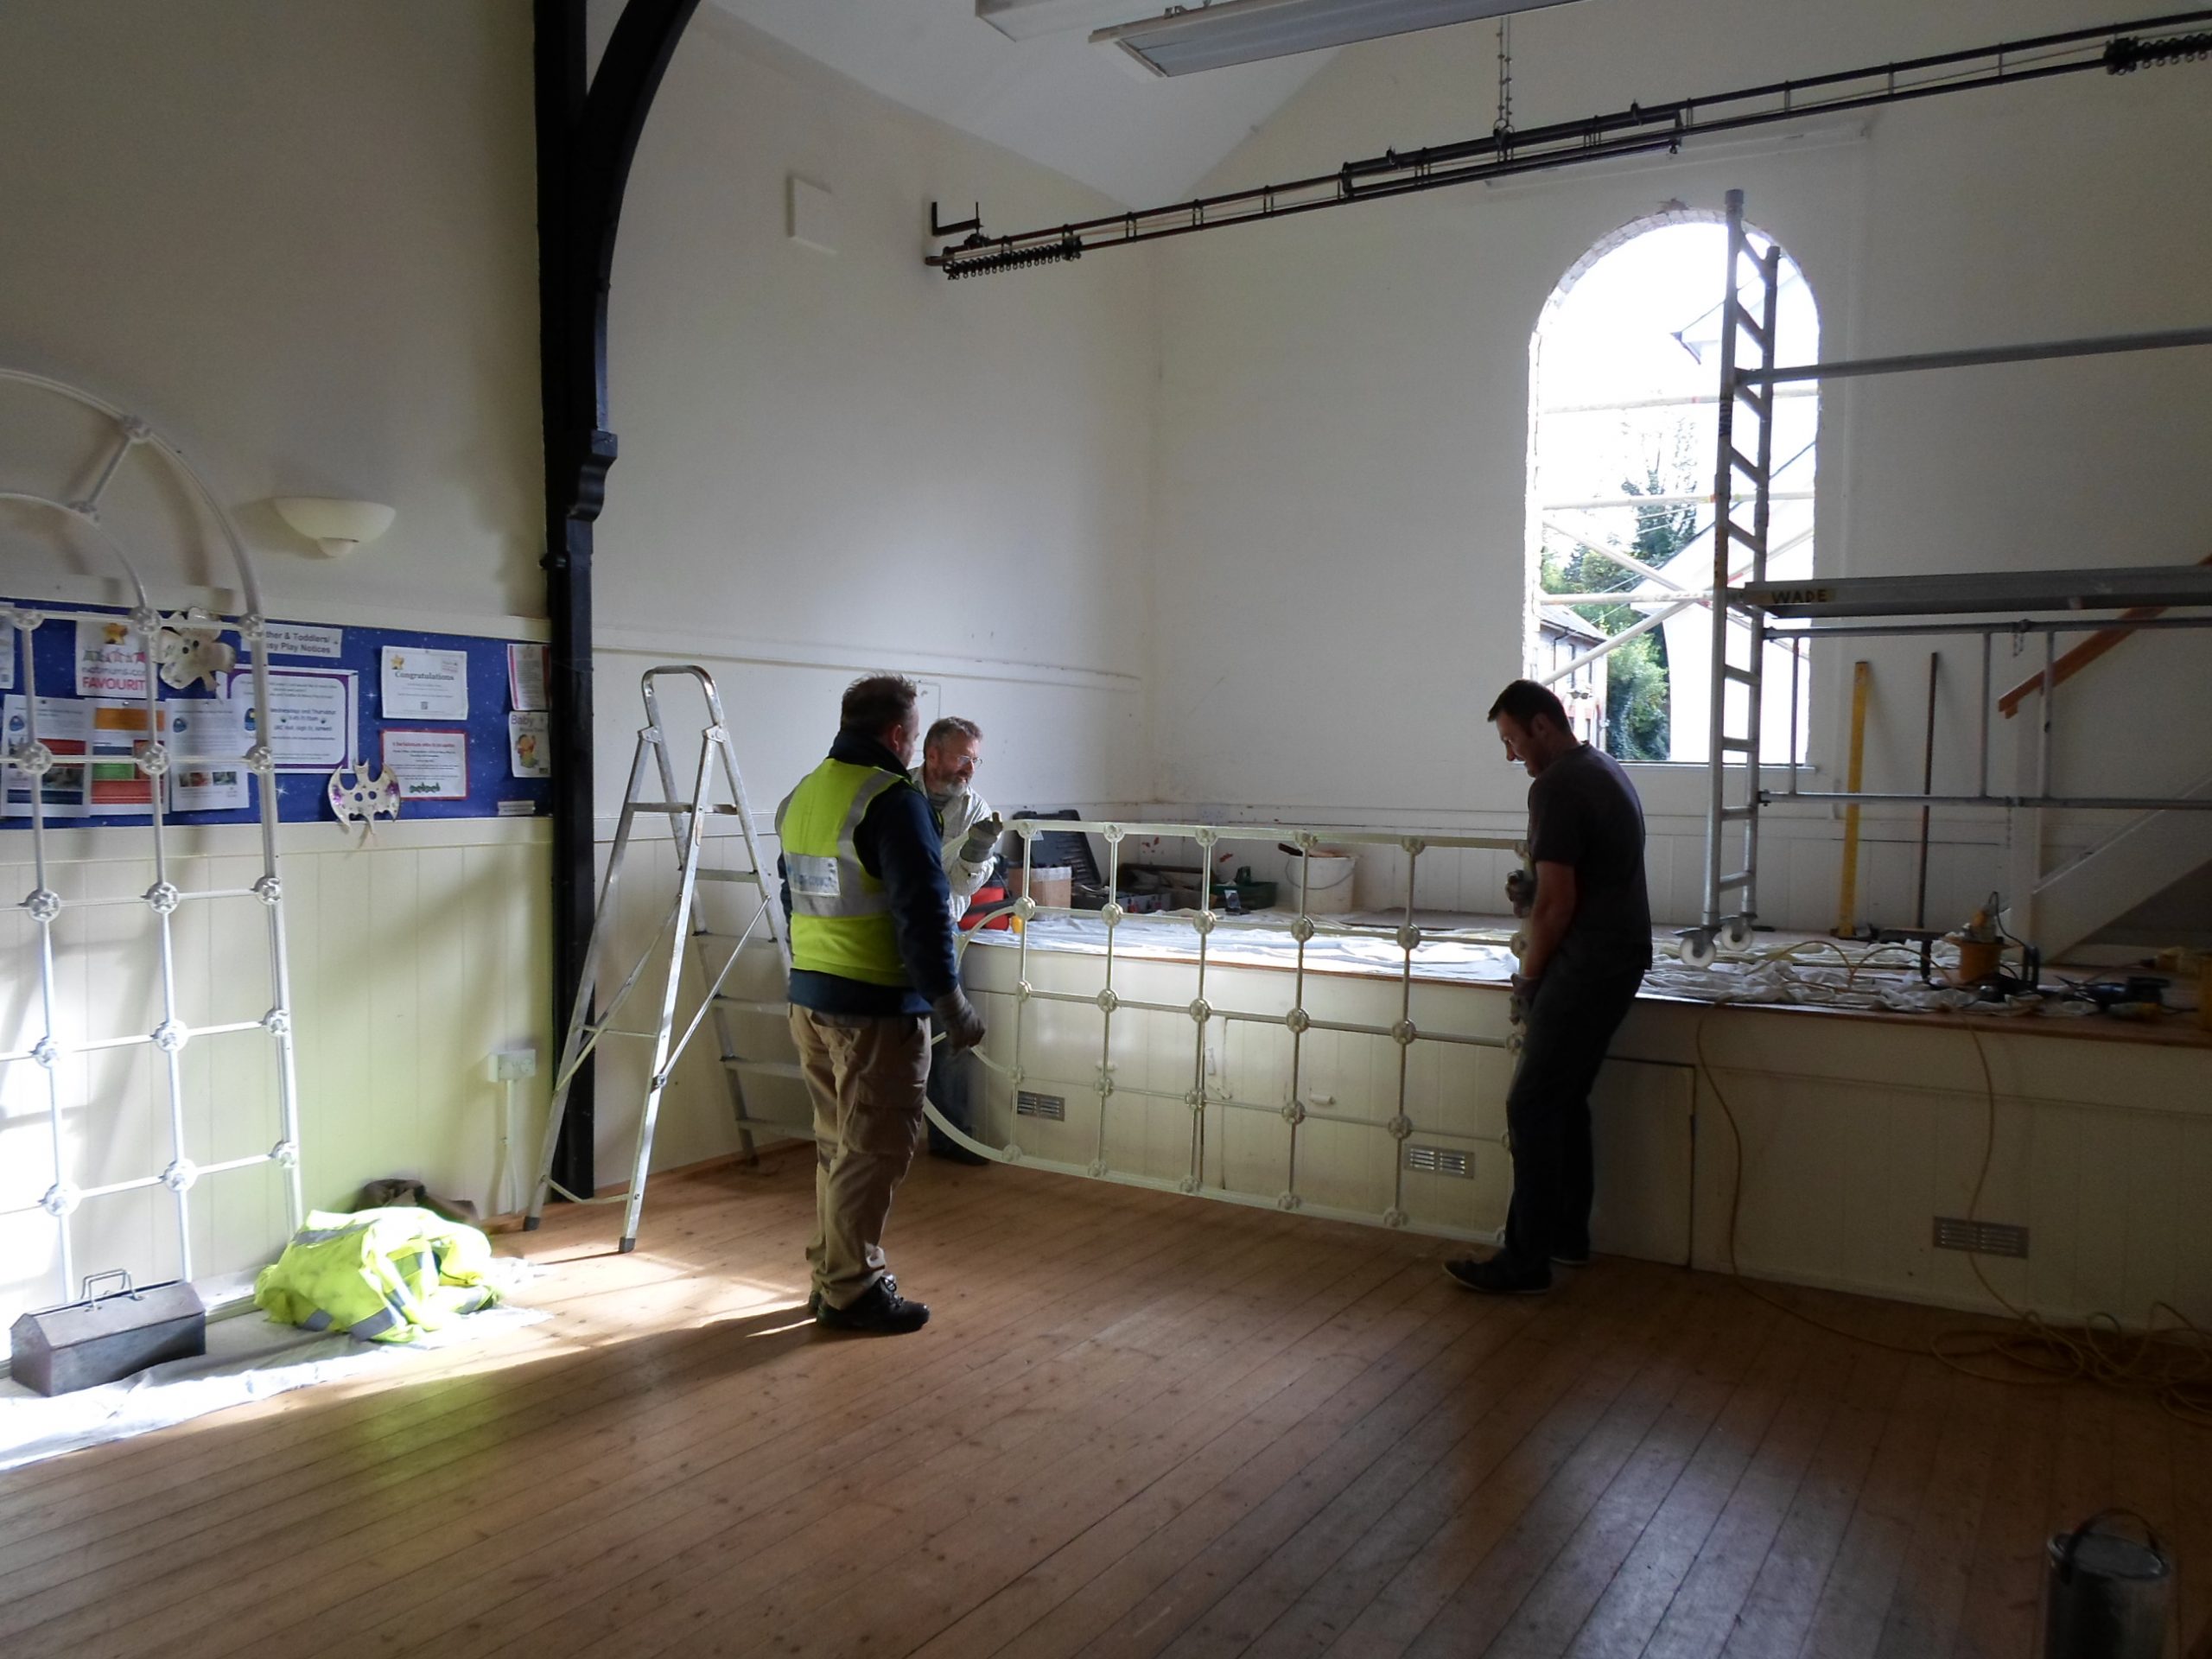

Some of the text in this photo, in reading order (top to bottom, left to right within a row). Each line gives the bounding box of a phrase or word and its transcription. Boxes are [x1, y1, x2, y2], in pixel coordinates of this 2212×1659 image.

[1770, 589, 1827, 604] WADE
[281, 642, 298, 652] Play
[301, 644, 331, 654] Notices
[82, 677, 146, 691] FAVOURIT
[511, 715, 533, 728] Baby
